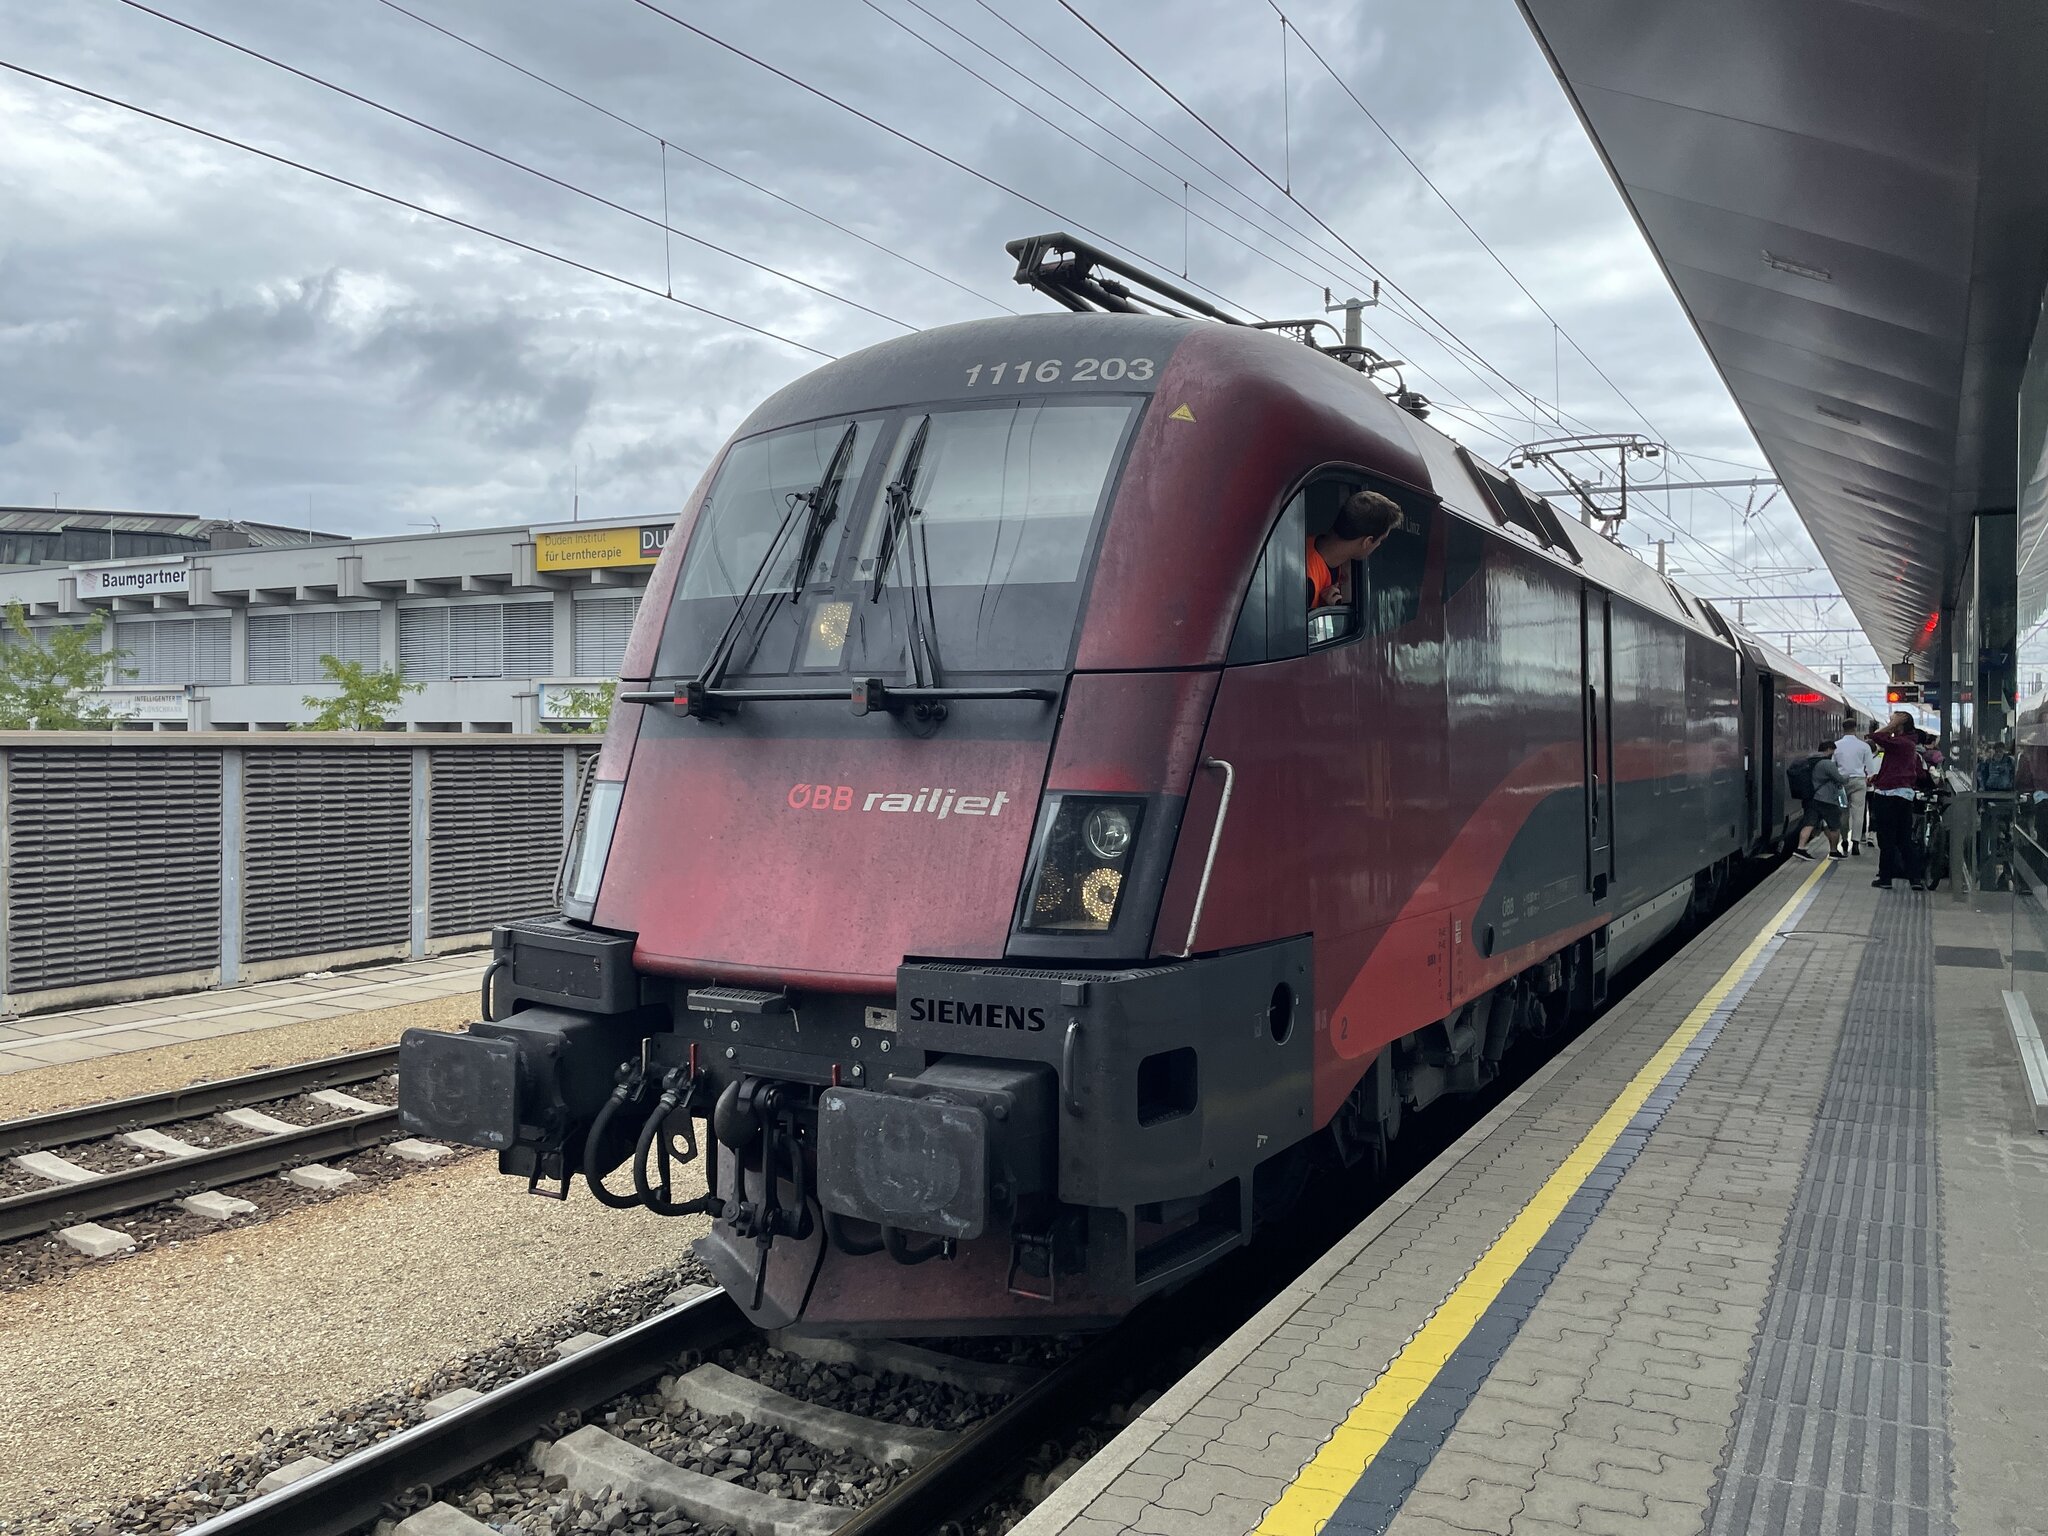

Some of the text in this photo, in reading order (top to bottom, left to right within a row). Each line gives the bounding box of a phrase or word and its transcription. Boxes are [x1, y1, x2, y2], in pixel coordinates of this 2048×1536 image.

[966, 357, 1155, 387] 1116 203
[545, 532, 607, 546] Duden Institut
[642, 529, 673, 549] DU
[545, 546, 622, 562] für Lerntherapie
[102, 569, 187, 589] Baumgartner
[2000, 653, 2008, 664] 7
[787, 783, 1010, 820] ÖBB railjet
[910, 997, 1046, 1032] SIEMENS
[1340, 1015, 1348, 1041] 2
